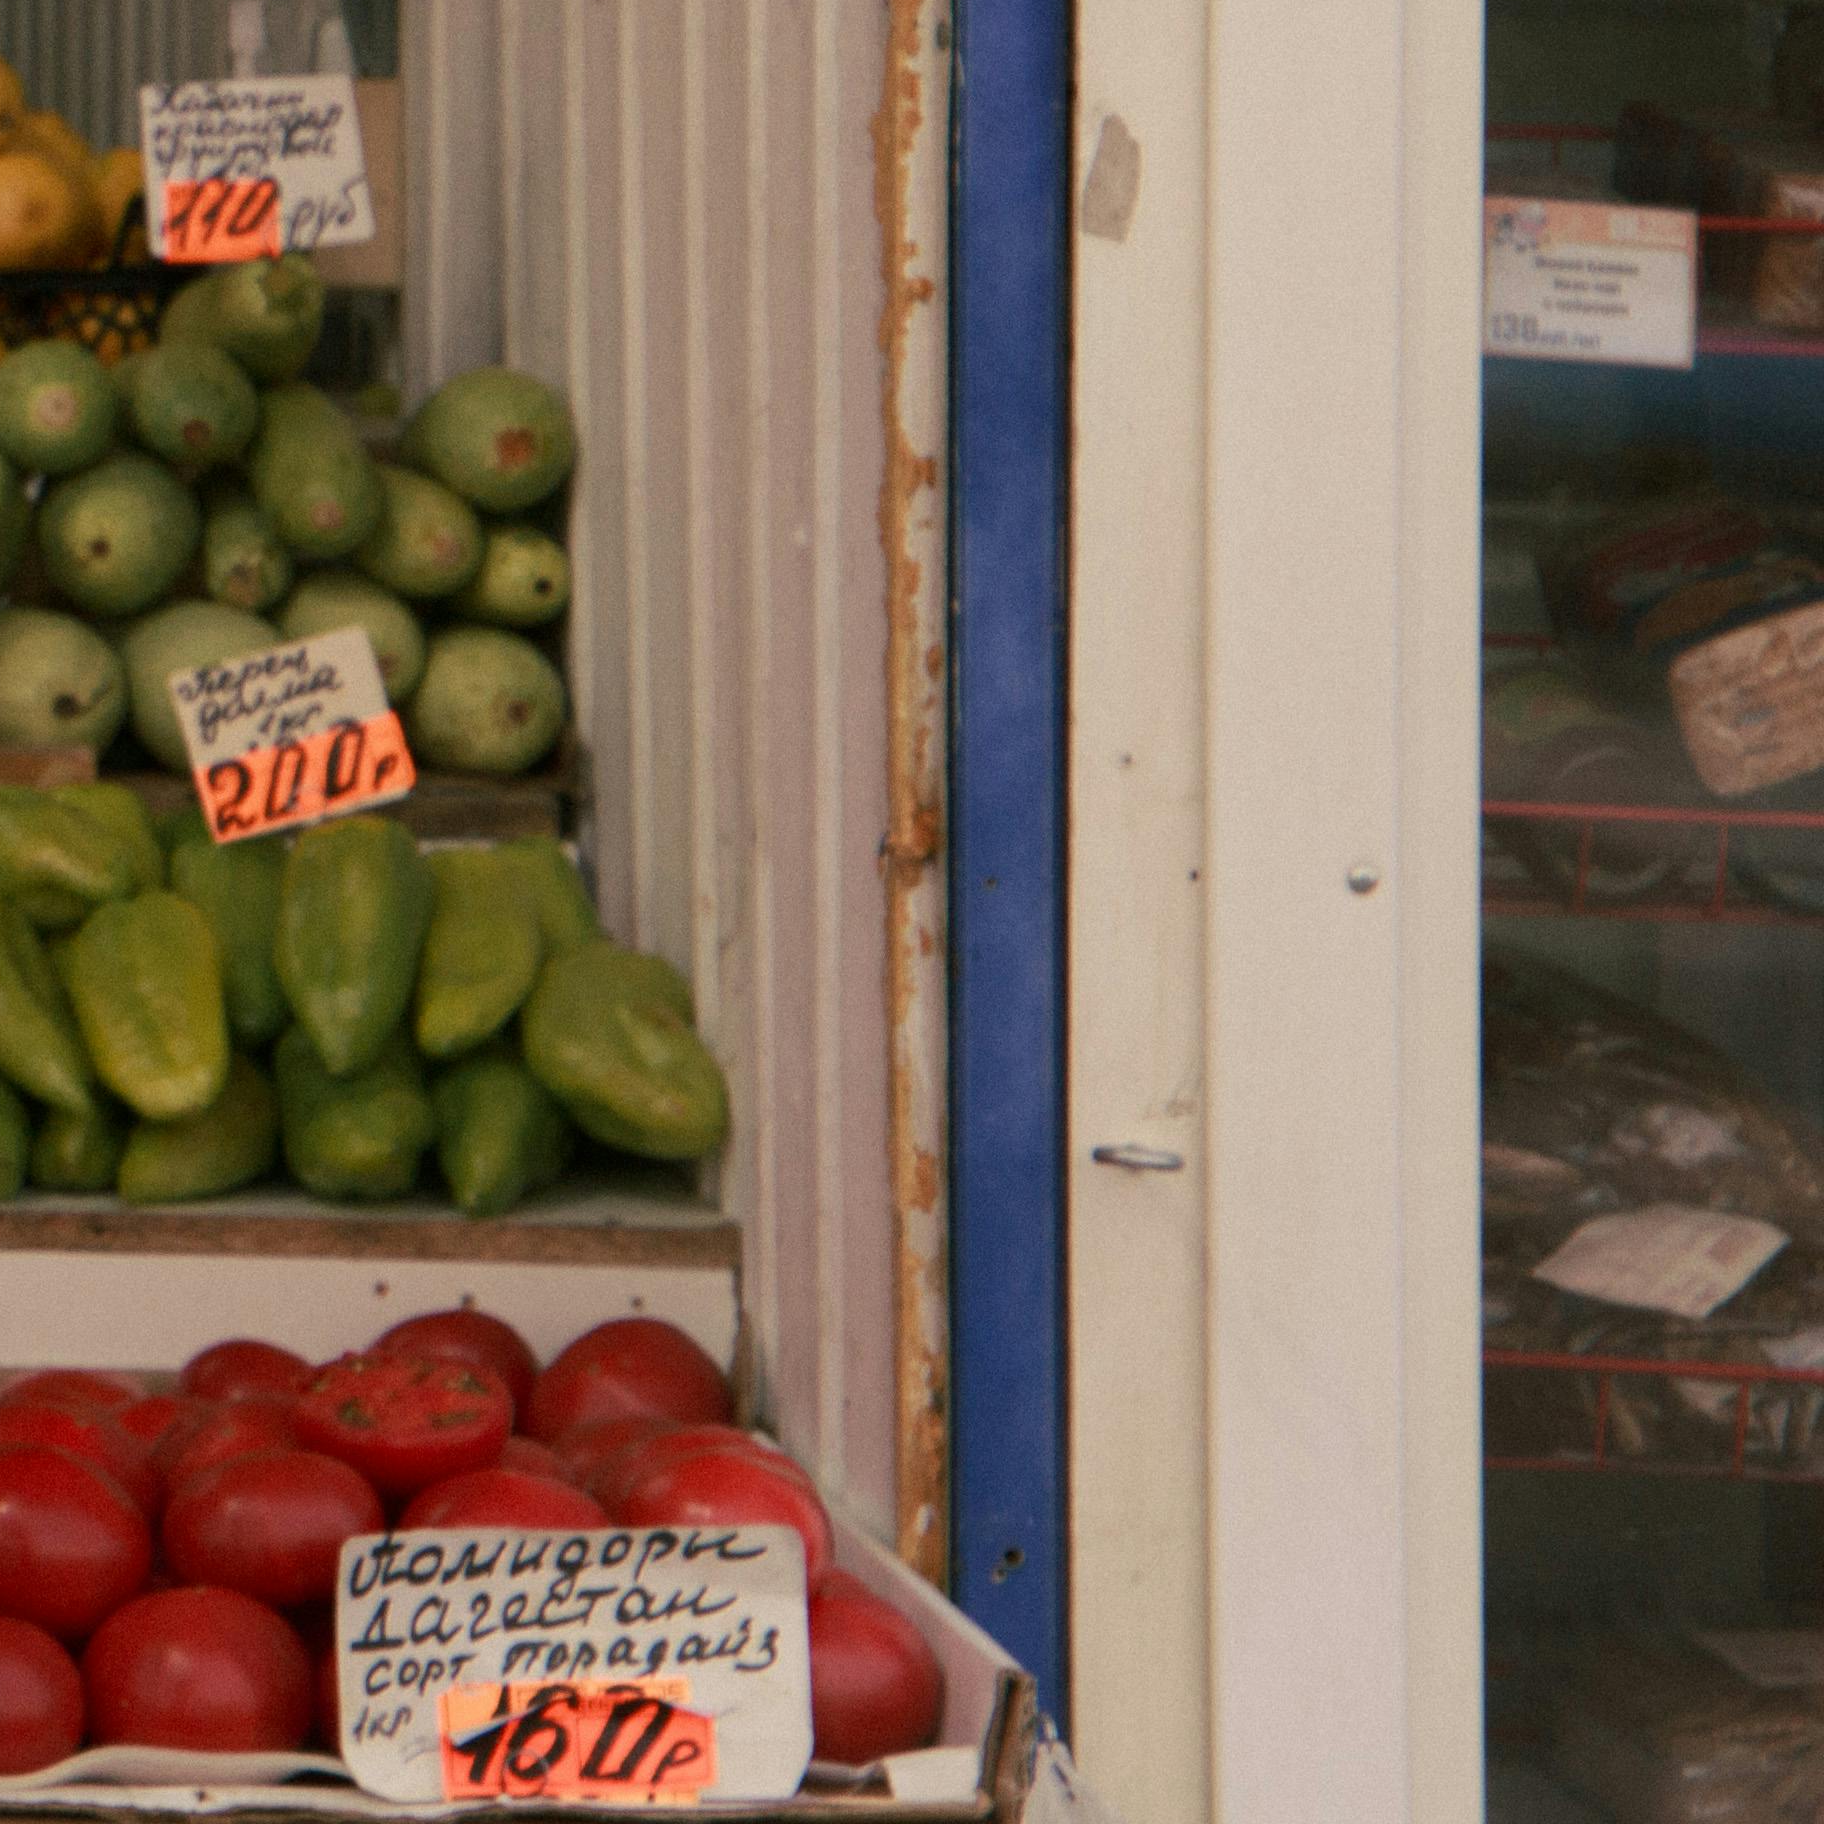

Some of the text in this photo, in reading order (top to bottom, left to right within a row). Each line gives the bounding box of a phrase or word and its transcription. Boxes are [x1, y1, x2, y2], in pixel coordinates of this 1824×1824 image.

[350, 1529, 768, 1598] Помидоры
[349, 1578, 738, 1652] Дагестан
[364, 1653, 478, 1697] сорт
